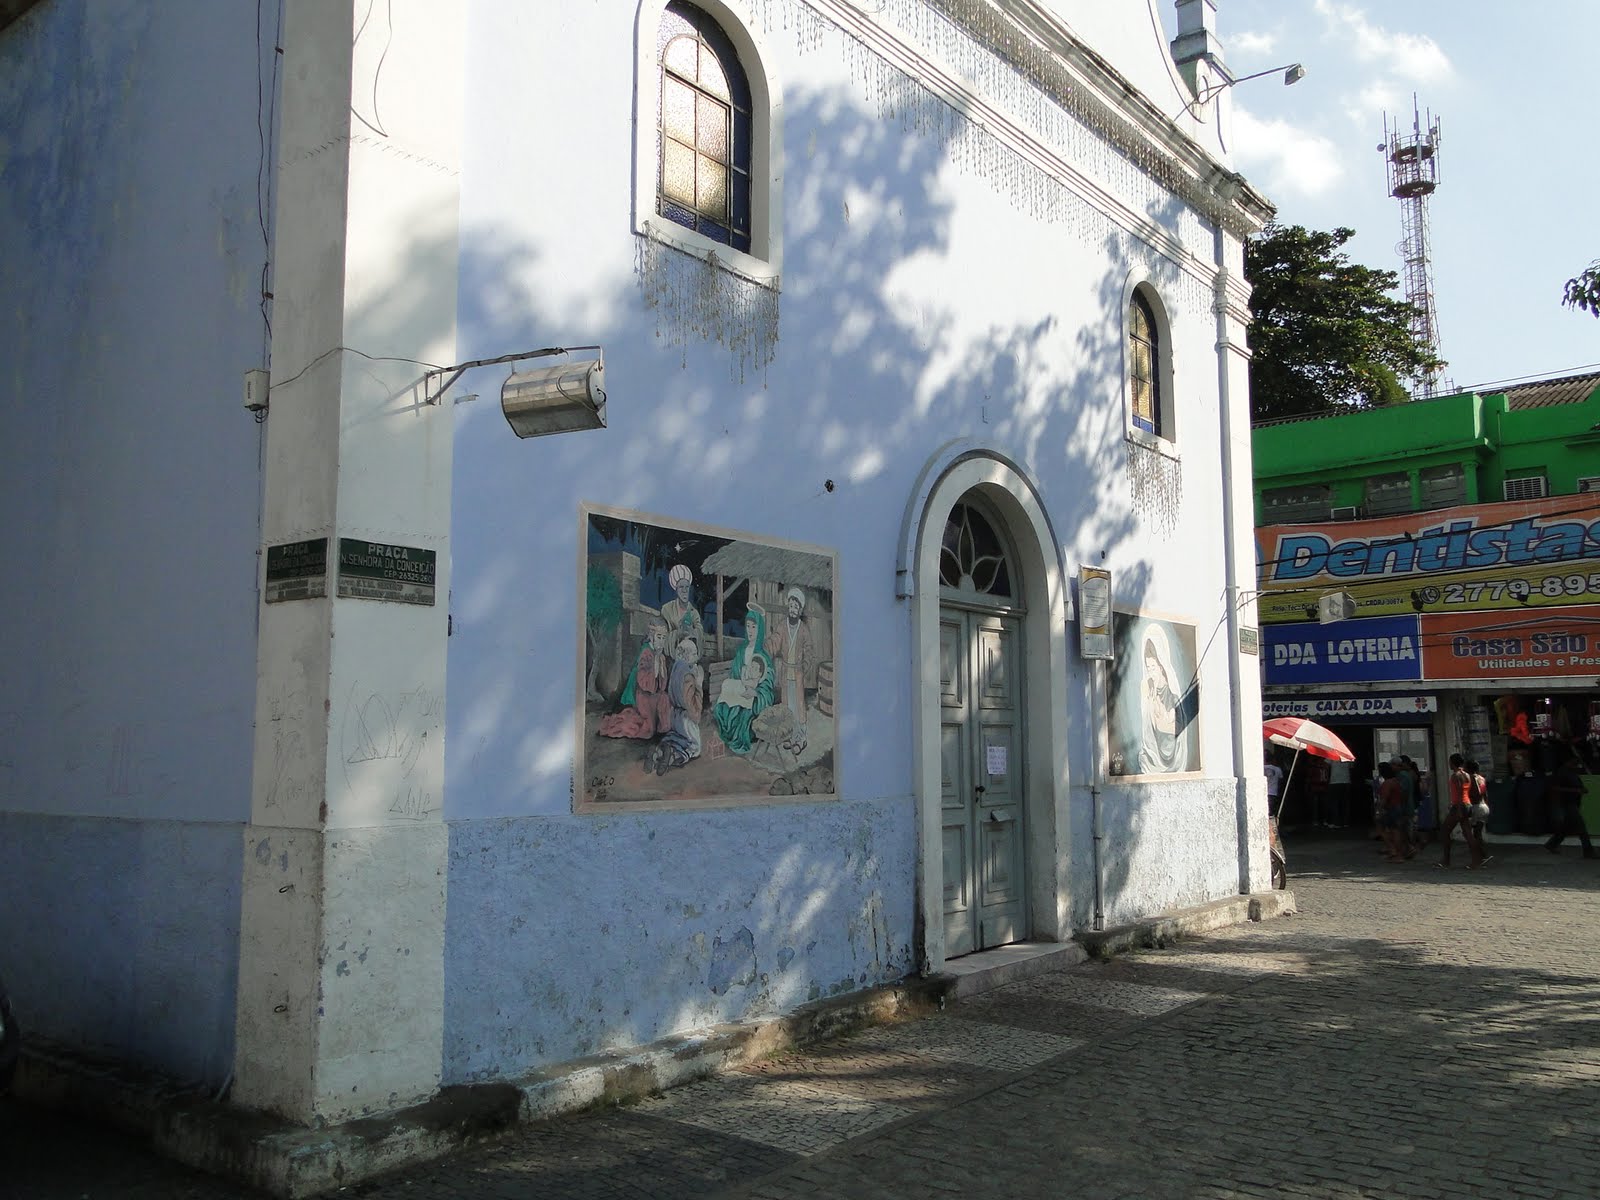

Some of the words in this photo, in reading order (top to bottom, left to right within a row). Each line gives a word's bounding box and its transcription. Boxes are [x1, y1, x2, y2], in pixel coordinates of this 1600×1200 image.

[1274, 643, 1317, 666] DDA
[1327, 636, 1416, 664] LOTERIA
[1452, 635, 1523, 658] Casa
[1530, 630, 1587, 655] São
[1478, 658, 1550, 669] Utilidades
[1556, 658, 1565, 666] e
[1263, 701, 1308, 713] oterias
[1315, 700, 1359, 712] CAIXA
[1363, 700, 1393, 711] DDA
